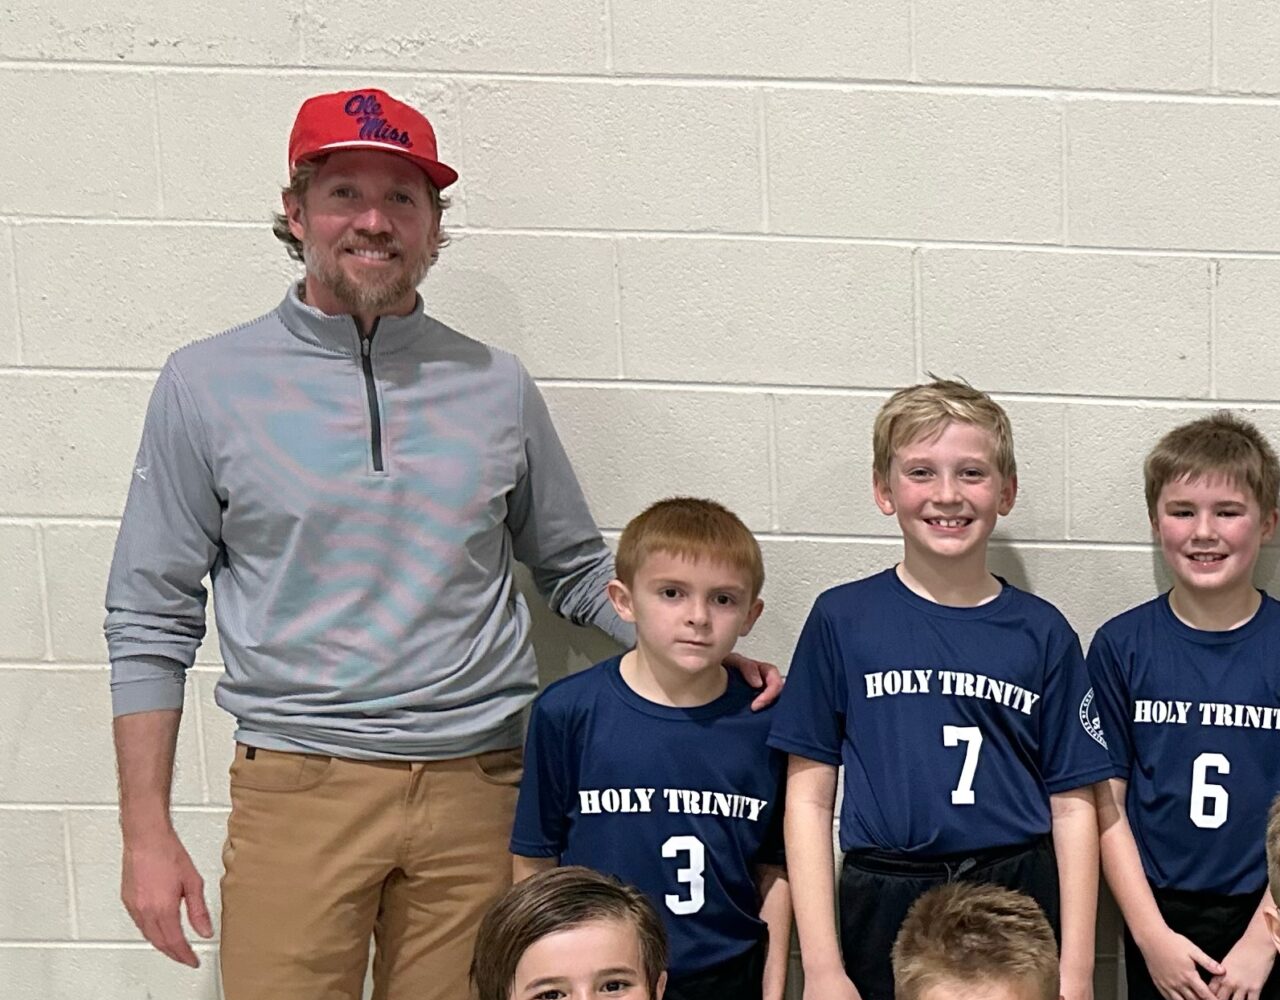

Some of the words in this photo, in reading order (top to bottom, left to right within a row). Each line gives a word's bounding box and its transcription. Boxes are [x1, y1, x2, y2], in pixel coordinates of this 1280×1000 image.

[345, 94, 384, 116] Ole
[357, 116, 413, 149] Miss
[864, 669, 933, 698] HOLY
[938, 670, 1041, 715] TRINITY
[1133, 700, 1193, 725] HOLY
[942, 725, 984, 805] 7
[578, 788, 655, 814] HOLY
[662, 788, 769, 822] TRINITY
[1189, 752, 1231, 829] 6
[661, 835, 706, 915] 3
